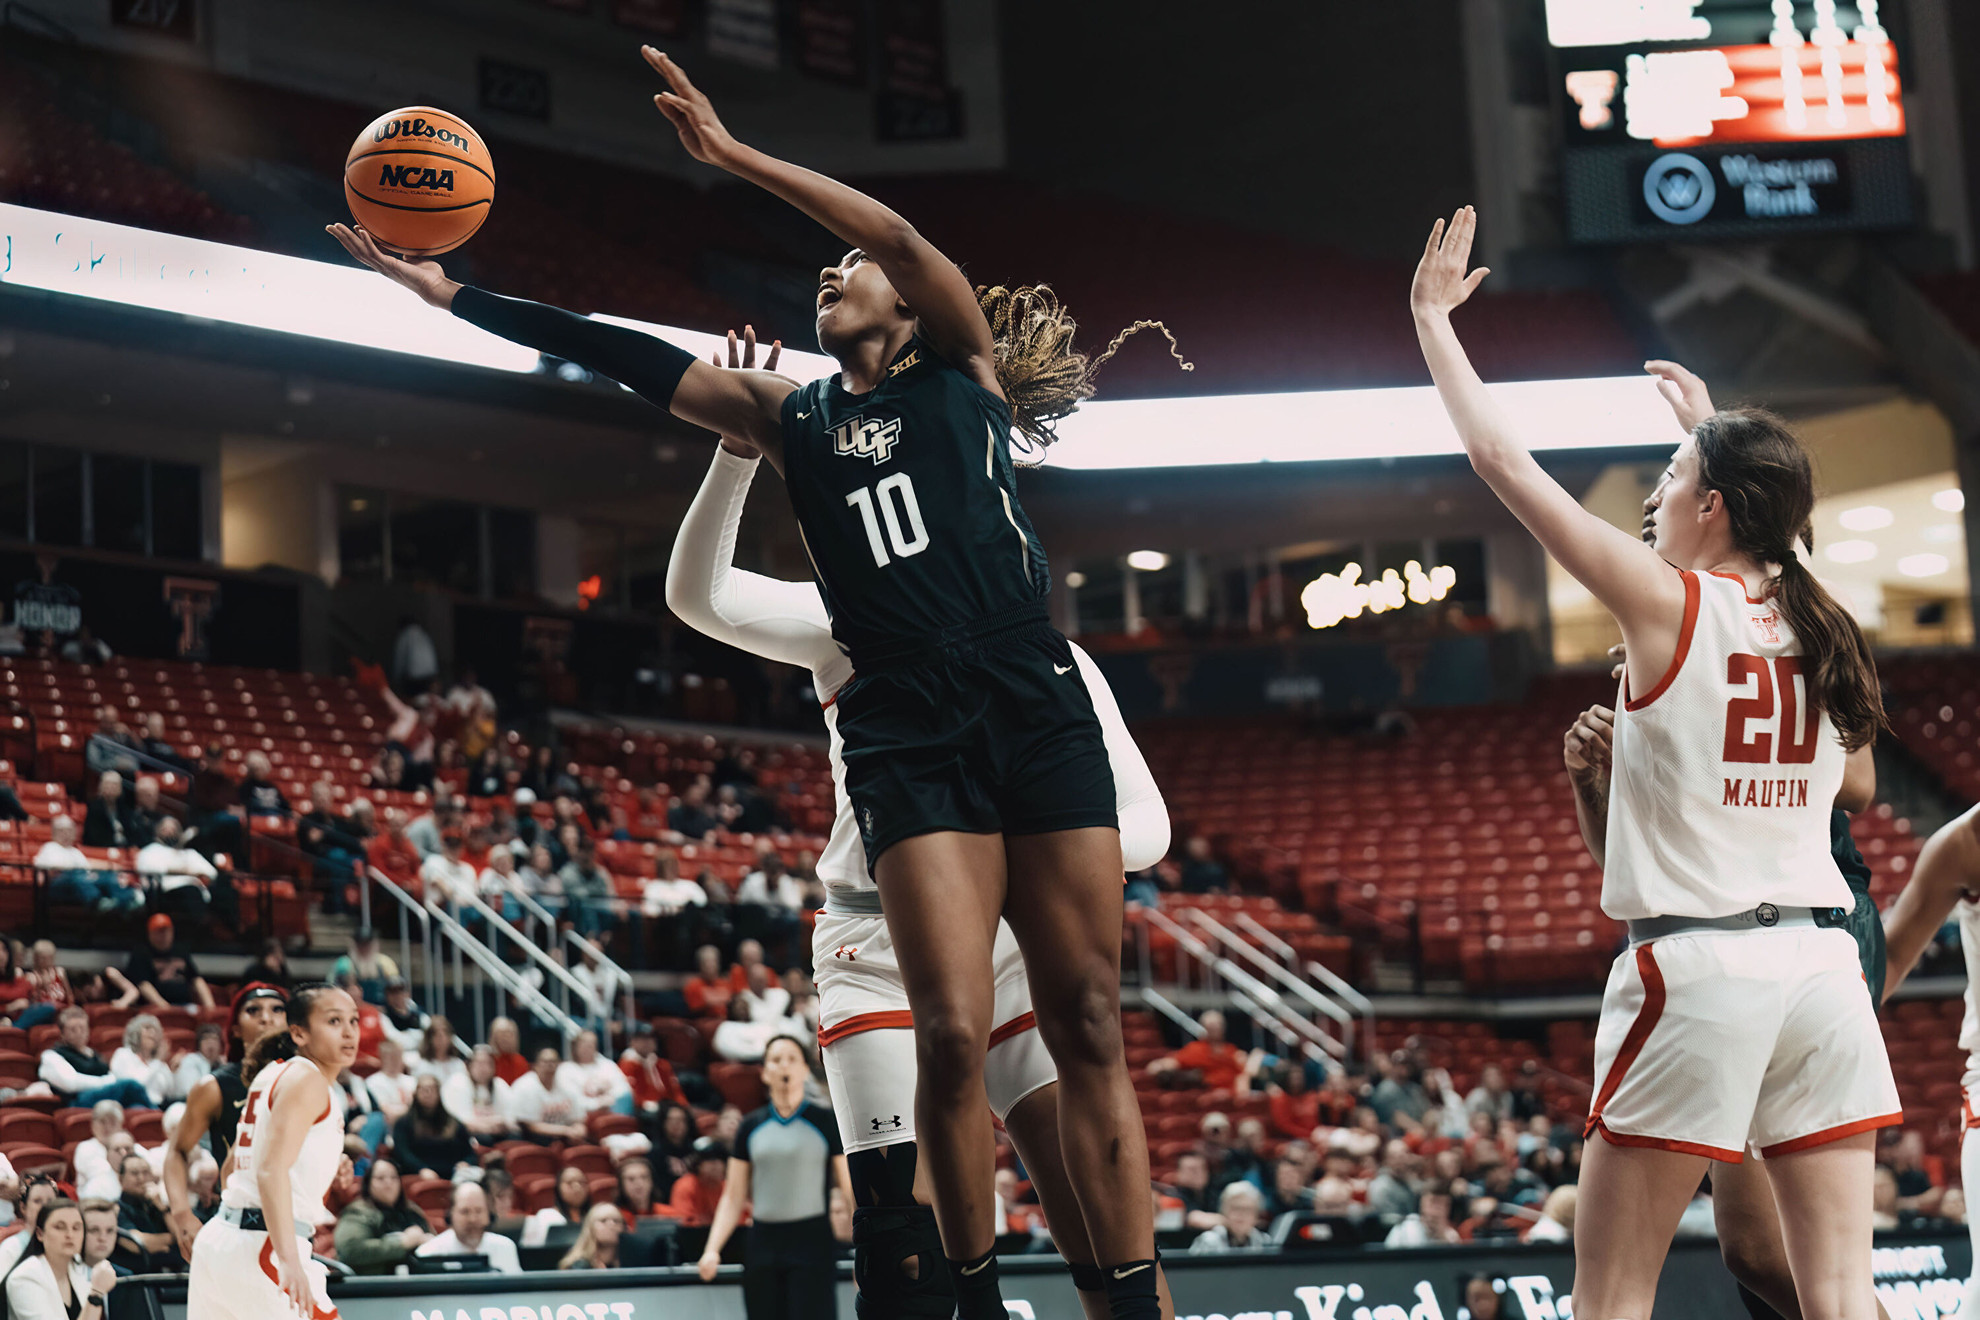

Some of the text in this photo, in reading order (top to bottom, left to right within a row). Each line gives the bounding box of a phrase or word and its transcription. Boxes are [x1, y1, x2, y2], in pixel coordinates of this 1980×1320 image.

[373, 118, 470, 153] Wilson
[379, 164, 454, 191] NCAA
[888, 349, 920, 378] XII
[825, 414, 902, 466] UCF
[845, 471, 930, 568] 10
[1722, 652, 1820, 765] 20
[1722, 778, 1808, 808] MAUPIN
